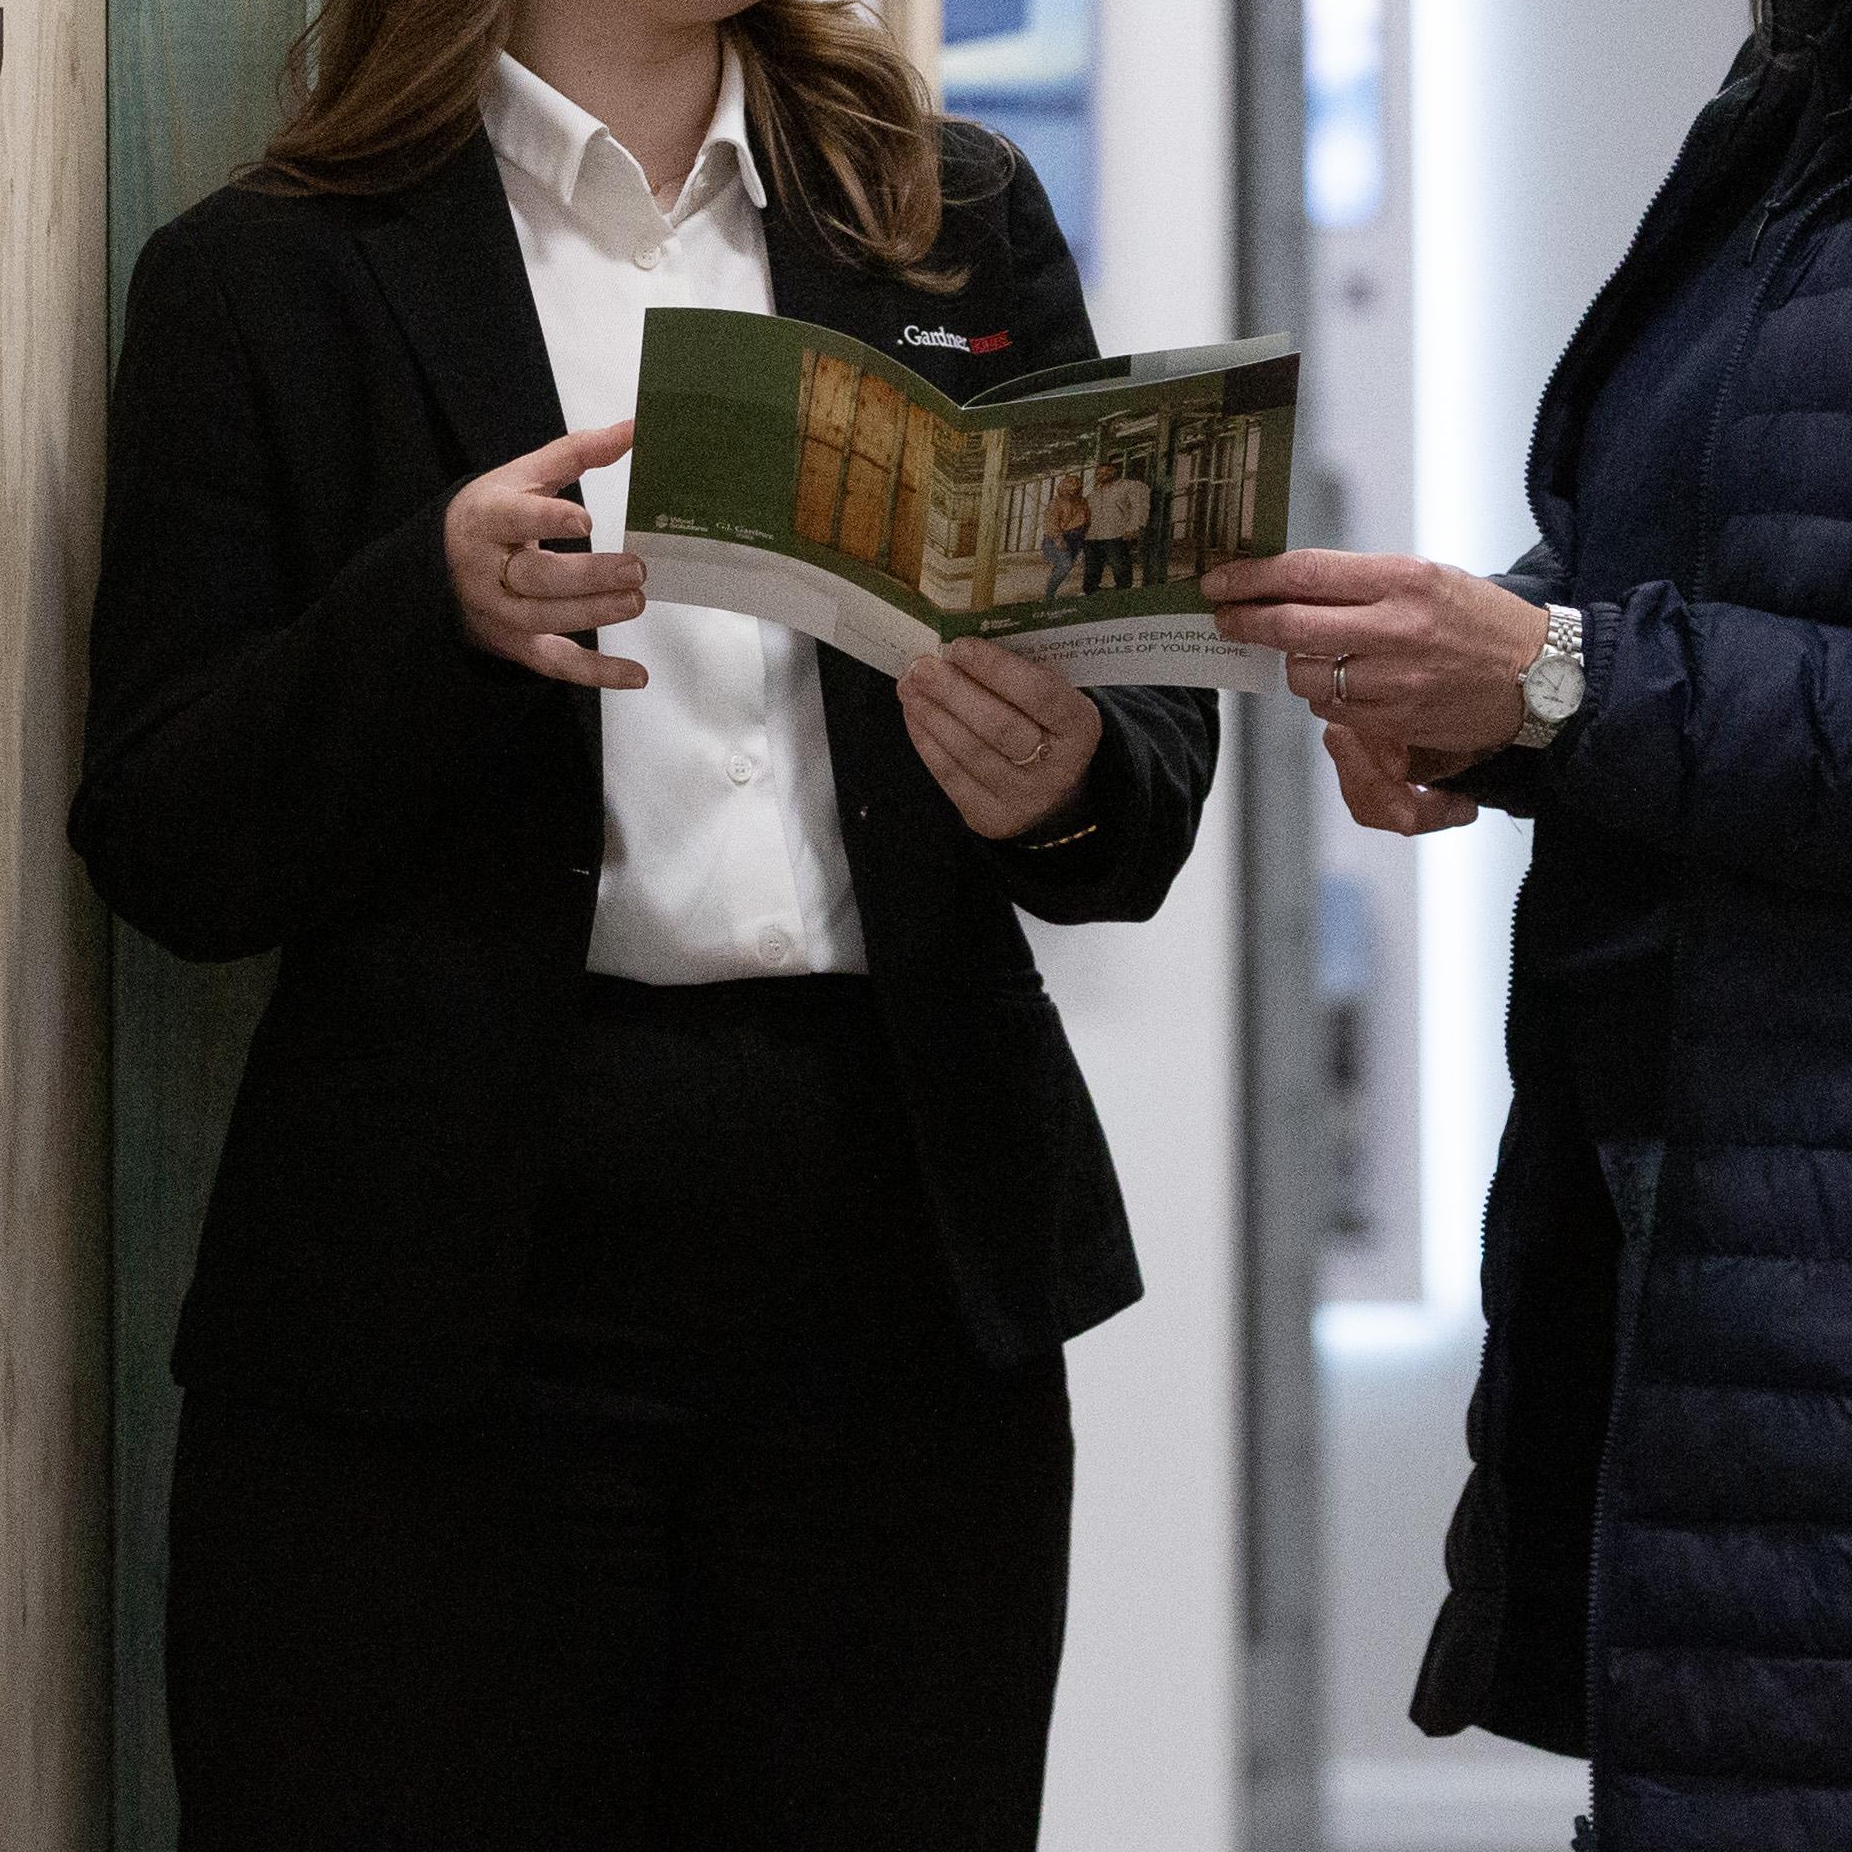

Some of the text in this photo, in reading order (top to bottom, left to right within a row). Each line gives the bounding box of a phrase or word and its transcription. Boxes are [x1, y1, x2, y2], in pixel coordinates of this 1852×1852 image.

[1039, 632, 1134, 652] SOMETHING
[1052, 650, 1079, 660] THE
[1082, 645, 1134, 656] WALLS
[1136, 643, 1156, 653] OF
[1161, 643, 1201, 654] YOUR
